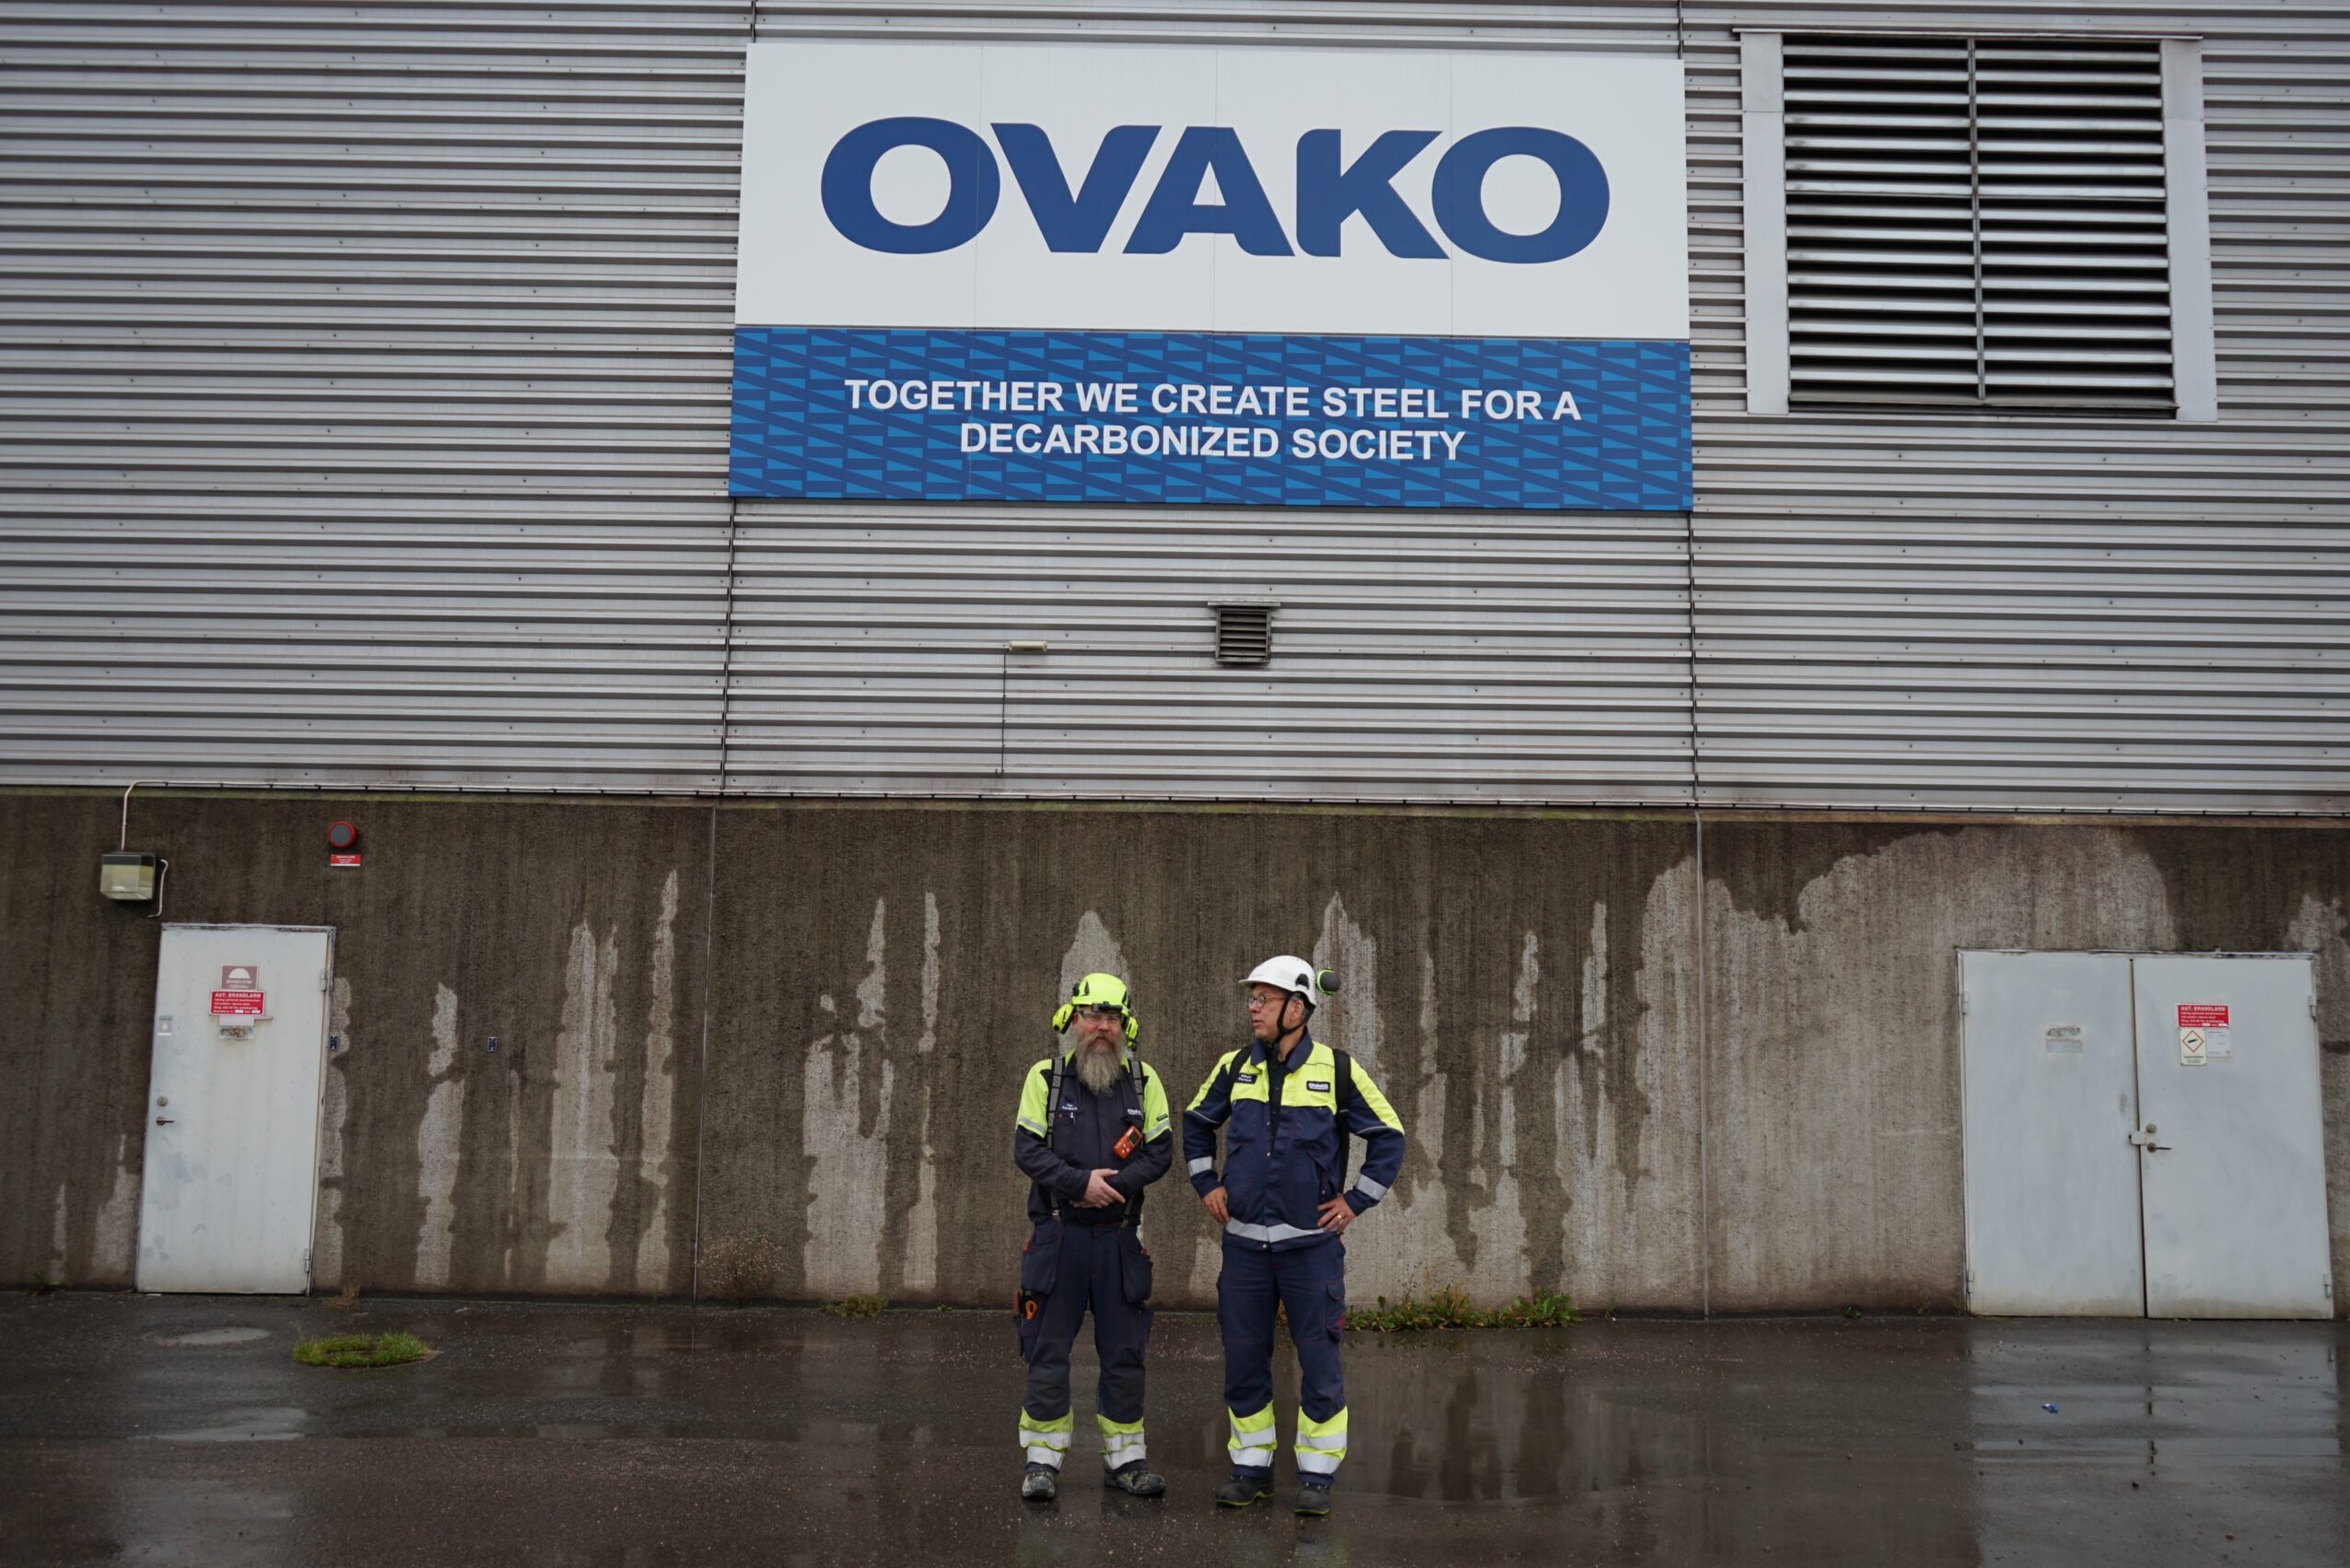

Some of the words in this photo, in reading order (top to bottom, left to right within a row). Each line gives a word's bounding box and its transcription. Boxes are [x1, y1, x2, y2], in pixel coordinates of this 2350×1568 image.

[821, 116, 1610, 264] OVAKO
[844, 379, 1065, 412] TOGETHER
[1075, 382, 1139, 413] WE
[1151, 382, 1310, 416] CREATE
[1322, 386, 1450, 418] STEEL
[1461, 389, 1544, 420] FOR
[1551, 391, 1582, 421] A
[960, 422, 1280, 458] DECARBONIZED
[1292, 427, 1467, 461] SOCIETY
